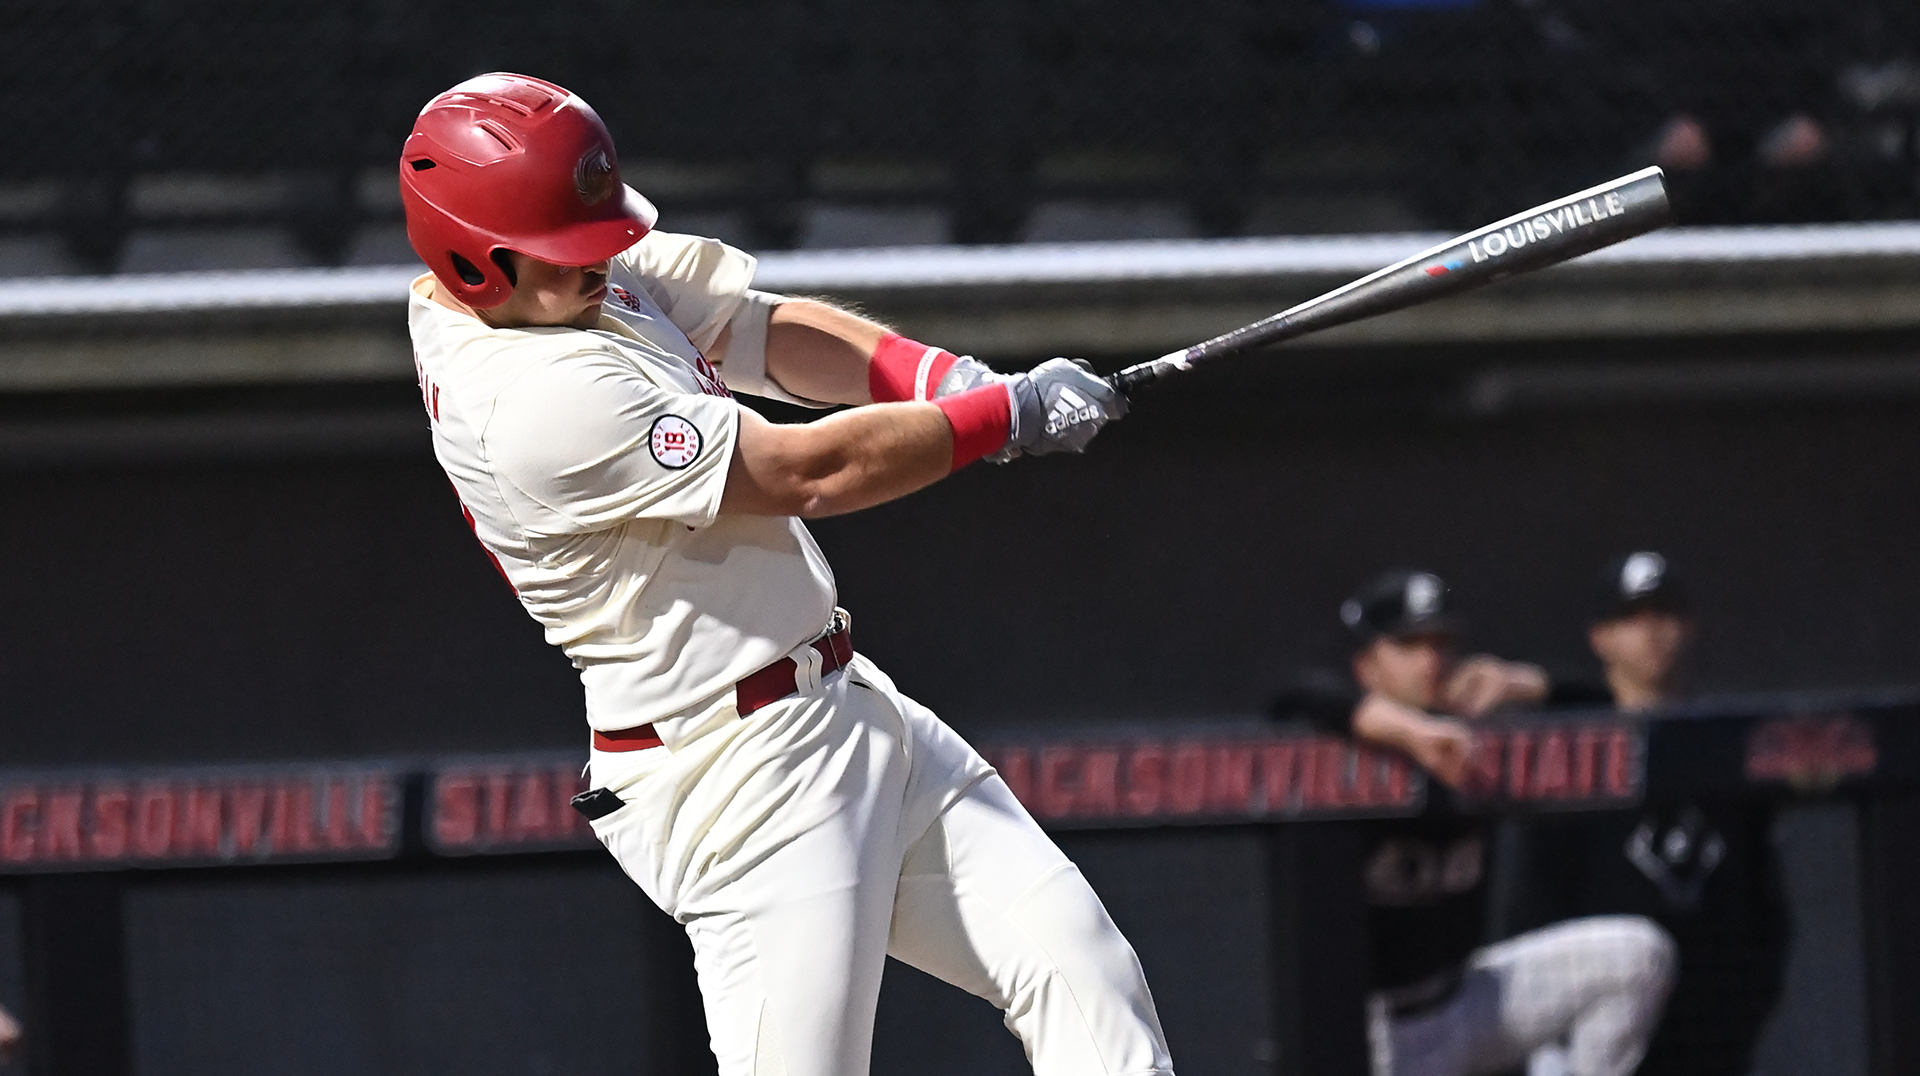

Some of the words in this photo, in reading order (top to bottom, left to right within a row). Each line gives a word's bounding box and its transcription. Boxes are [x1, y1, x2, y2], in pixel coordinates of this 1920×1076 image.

[1468, 191, 1625, 263] LOUISVILLE
[1045, 404, 1099, 434] adidas
[654, 425, 664, 457] RUDY
[665, 432, 685, 451] 18
[680, 422, 696, 463] ABBOTT
[998, 737, 1412, 817] ACKSONVILLE
[437, 772, 590, 841] STAT
